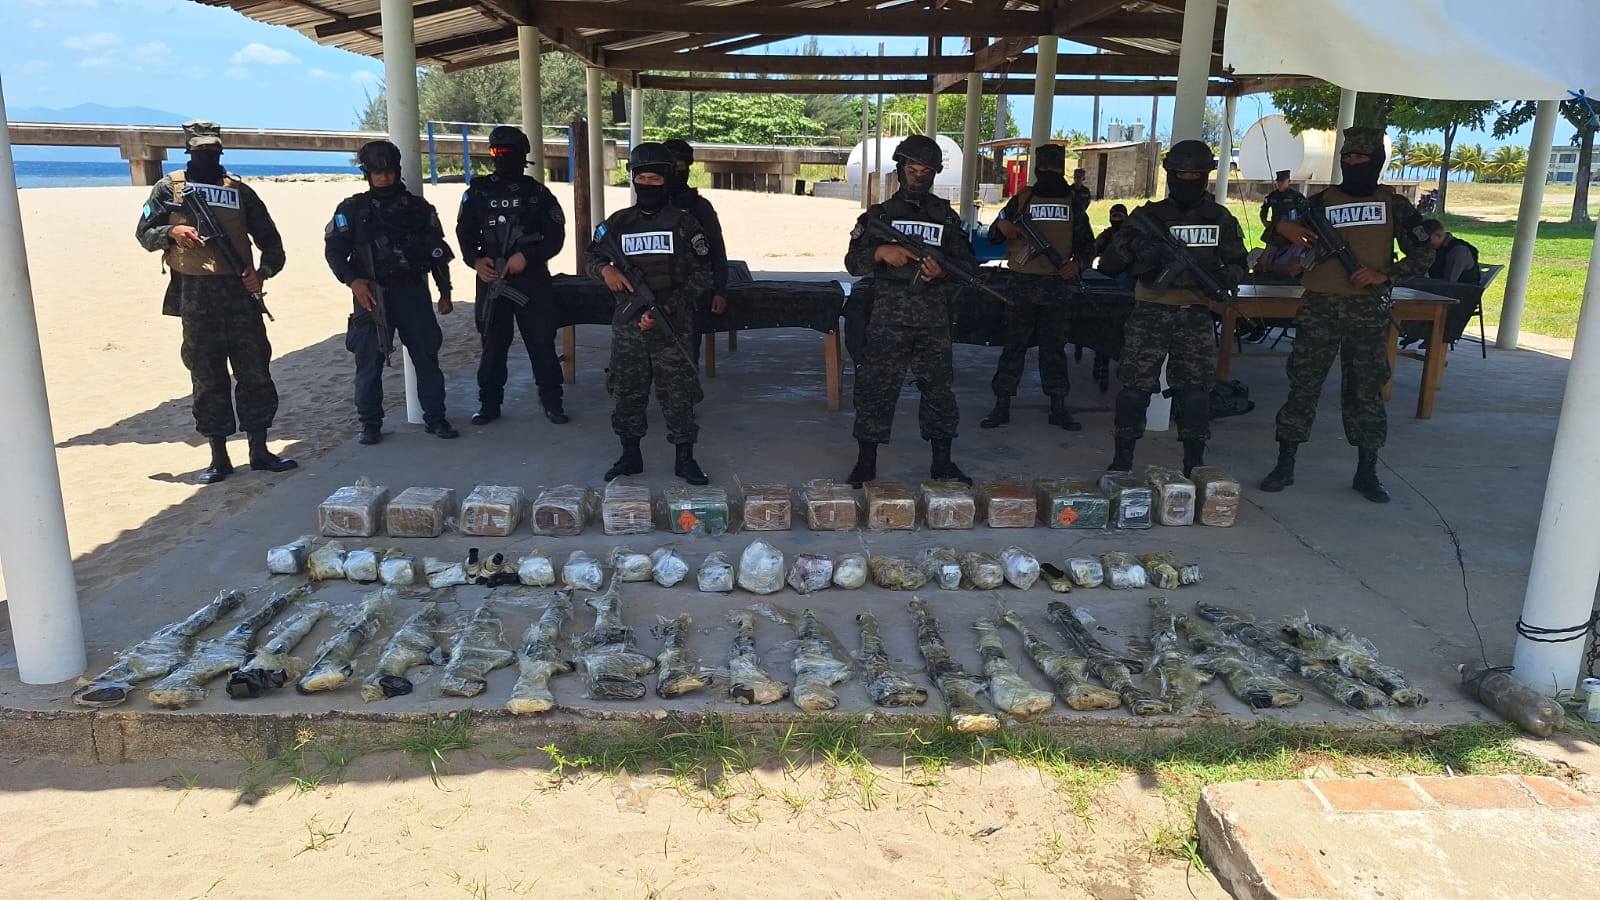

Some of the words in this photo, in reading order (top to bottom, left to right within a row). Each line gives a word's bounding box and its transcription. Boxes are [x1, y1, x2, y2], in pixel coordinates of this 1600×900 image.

[490, 199, 520, 208] COE
[1032, 206, 1067, 218] NAVAL
[1330, 206, 1381, 224] NAVAL
[625, 235, 670, 252] NAVAL
